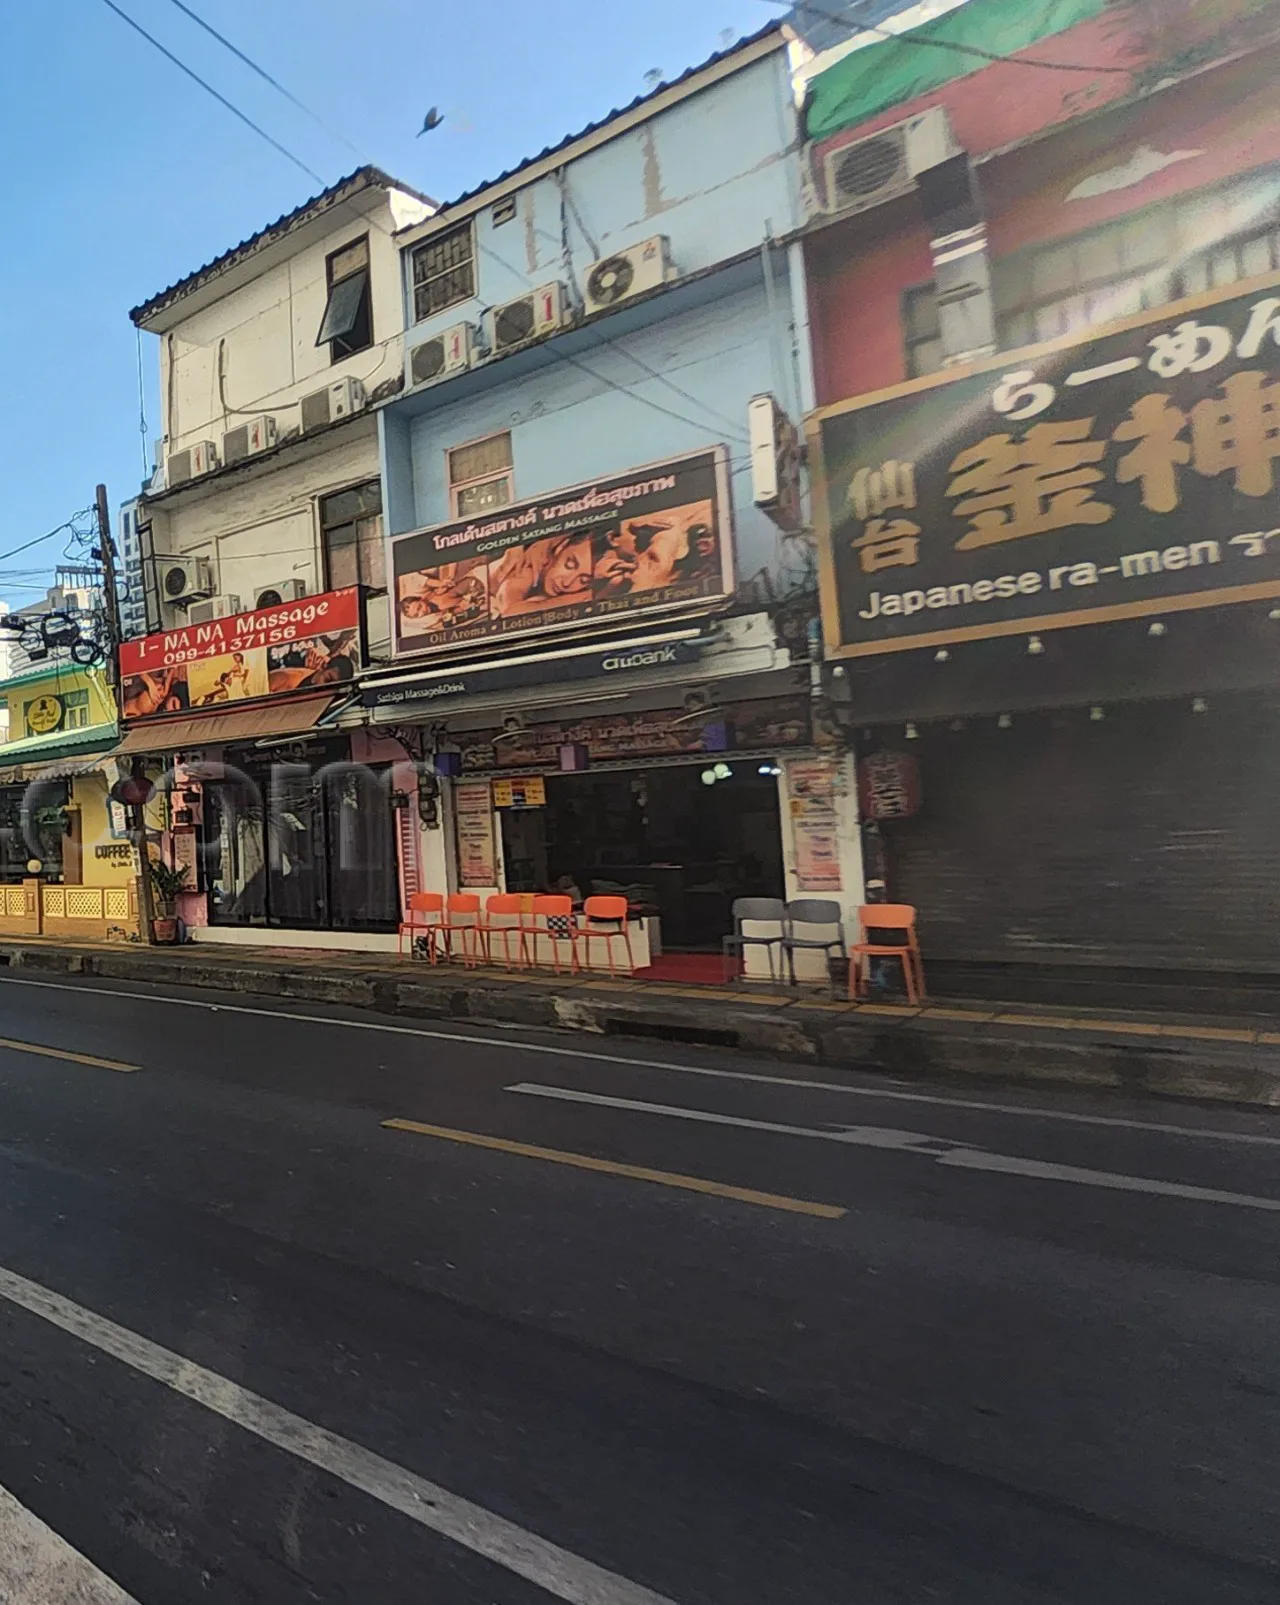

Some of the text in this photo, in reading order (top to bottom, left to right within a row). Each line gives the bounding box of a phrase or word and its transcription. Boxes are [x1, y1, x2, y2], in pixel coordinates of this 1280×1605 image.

[476, 509, 619, 552] GOLDEN SATANG MASSAGE
[858, 539, 1220, 619] Japanese ra-men
[236, 600, 329, 636] Massage
[429, 631, 447, 645] Oil
[450, 626, 486, 642] Aroma
[502, 615, 542, 632] Lotion
[547, 609, 580, 627] Body
[598, 599, 629, 613] Thai
[633, 592, 659, 605] and
[163, 625, 297, 666] 099-4137156
[95, 844, 131, 859] COFFEE
